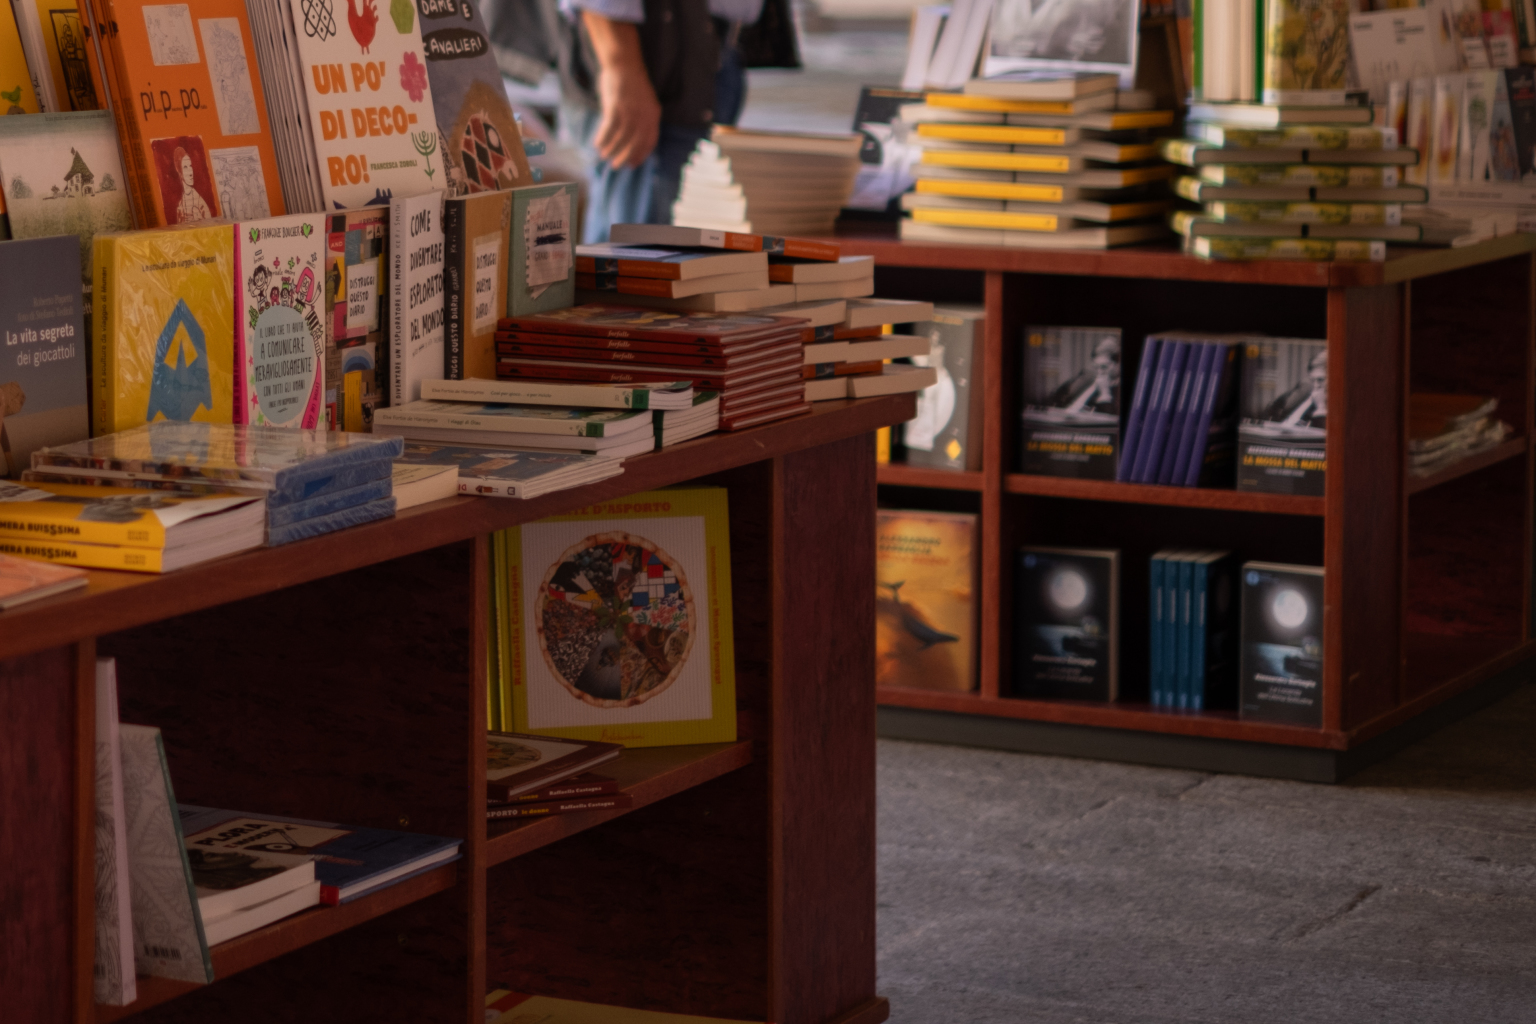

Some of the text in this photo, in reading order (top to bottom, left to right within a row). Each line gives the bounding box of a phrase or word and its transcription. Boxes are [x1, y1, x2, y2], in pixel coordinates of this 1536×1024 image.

[462, 3, 471, 18] E
[311, 61, 386, 95] UN PO'
[319, 104, 418, 141] DI DECO-
[327, 154, 418, 187] RO! FRANCESCA ZOBOLI
[410, 209, 431, 238] COME
[536, 220, 563, 232] MANUALE
[330, 240, 343, 248] AND
[410, 242, 442, 272] DIVENTARE
[476, 252, 497, 270] DISTRUGGI
[349, 276, 375, 290] DISTRUGGI
[475, 277, 491, 294] QUESTO
[349, 290, 369, 303] QUESTO
[349, 304, 366, 317] DIARIO
[475, 302, 489, 321] DIARIO
[99, 266, 108, 376] sculture da viaggio di Munari
[394, 297, 402, 344] ESPLORATORE
[410, 307, 445, 343] DEL MONDO
[450, 294, 459, 352] QUESTO DIARIO
[6, 323, 75, 346] La vita segreta
[264, 326, 277, 338] LIBRO
[277, 325, 285, 336] CHE
[17, 343, 75, 367] dei giocattoli
[260, 336, 305, 360] A COMUNICARE
[395, 348, 402, 359] UN
[611, 352, 635, 360] farfalle
[255, 356, 312, 383] MERAVIGLIOSAMENTE
[610, 374, 633, 382] farfalle
[263, 378, 305, 397] CON TUTTI UMANI
[1027, 441, 1114, 456] LA MOSSA DEL MATTO
[1242, 454, 1327, 472] LA MOSSA DEL MATTO
[592, 501, 672, 515] D'ASPORTO
[27, 521, 81, 537] BUISSSIMA
[25, 544, 78, 560] BUISSSIMA
[510, 565, 521, 686] Raffaella Castagna
